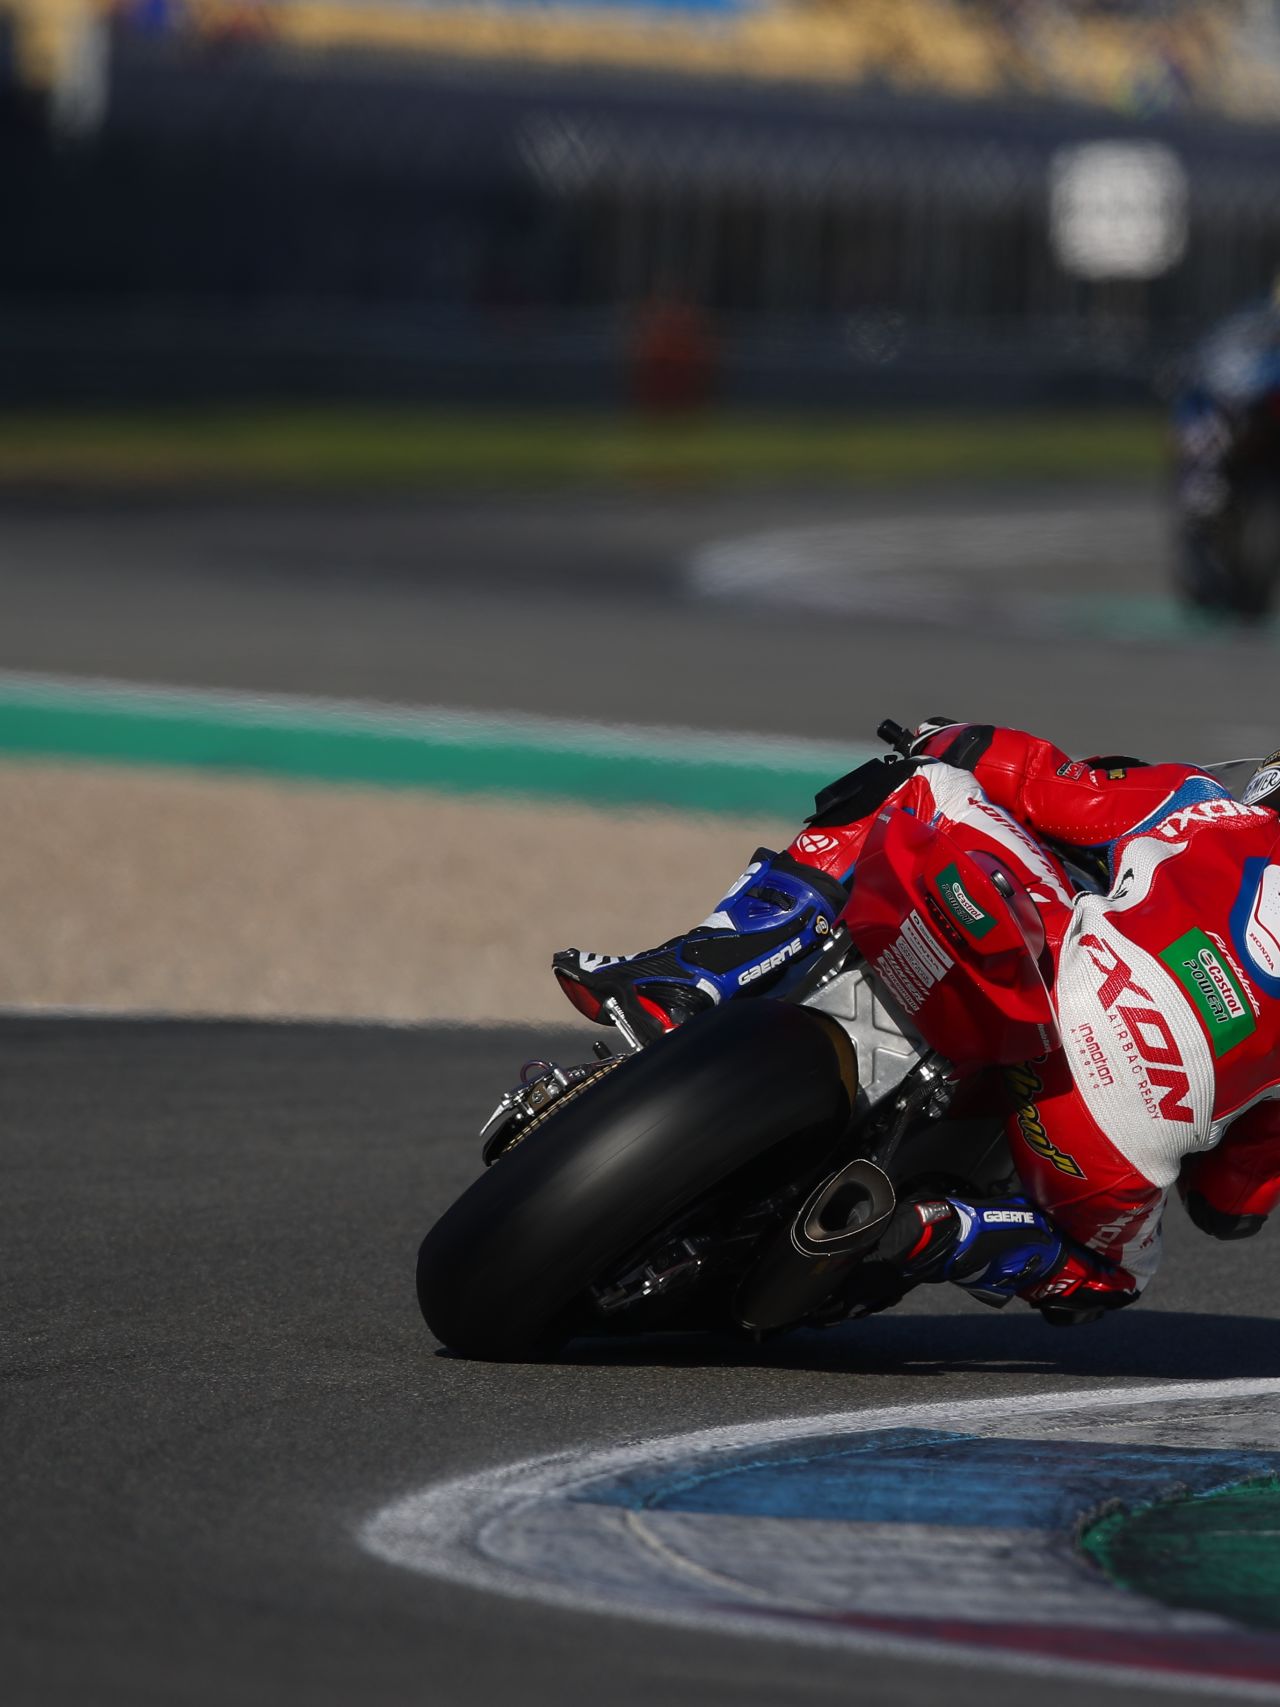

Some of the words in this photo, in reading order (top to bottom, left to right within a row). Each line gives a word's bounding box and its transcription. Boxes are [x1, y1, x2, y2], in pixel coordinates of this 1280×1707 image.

[956, 892, 982, 919] Castrol
[1249, 932, 1275, 971] HONDA
[1183, 959, 1229, 1024] POWER1
[1208, 965, 1242, 1016] Castrol
[1109, 1014, 1143, 1075] AIRBAG
[1137, 1081, 1161, 1120] READY
